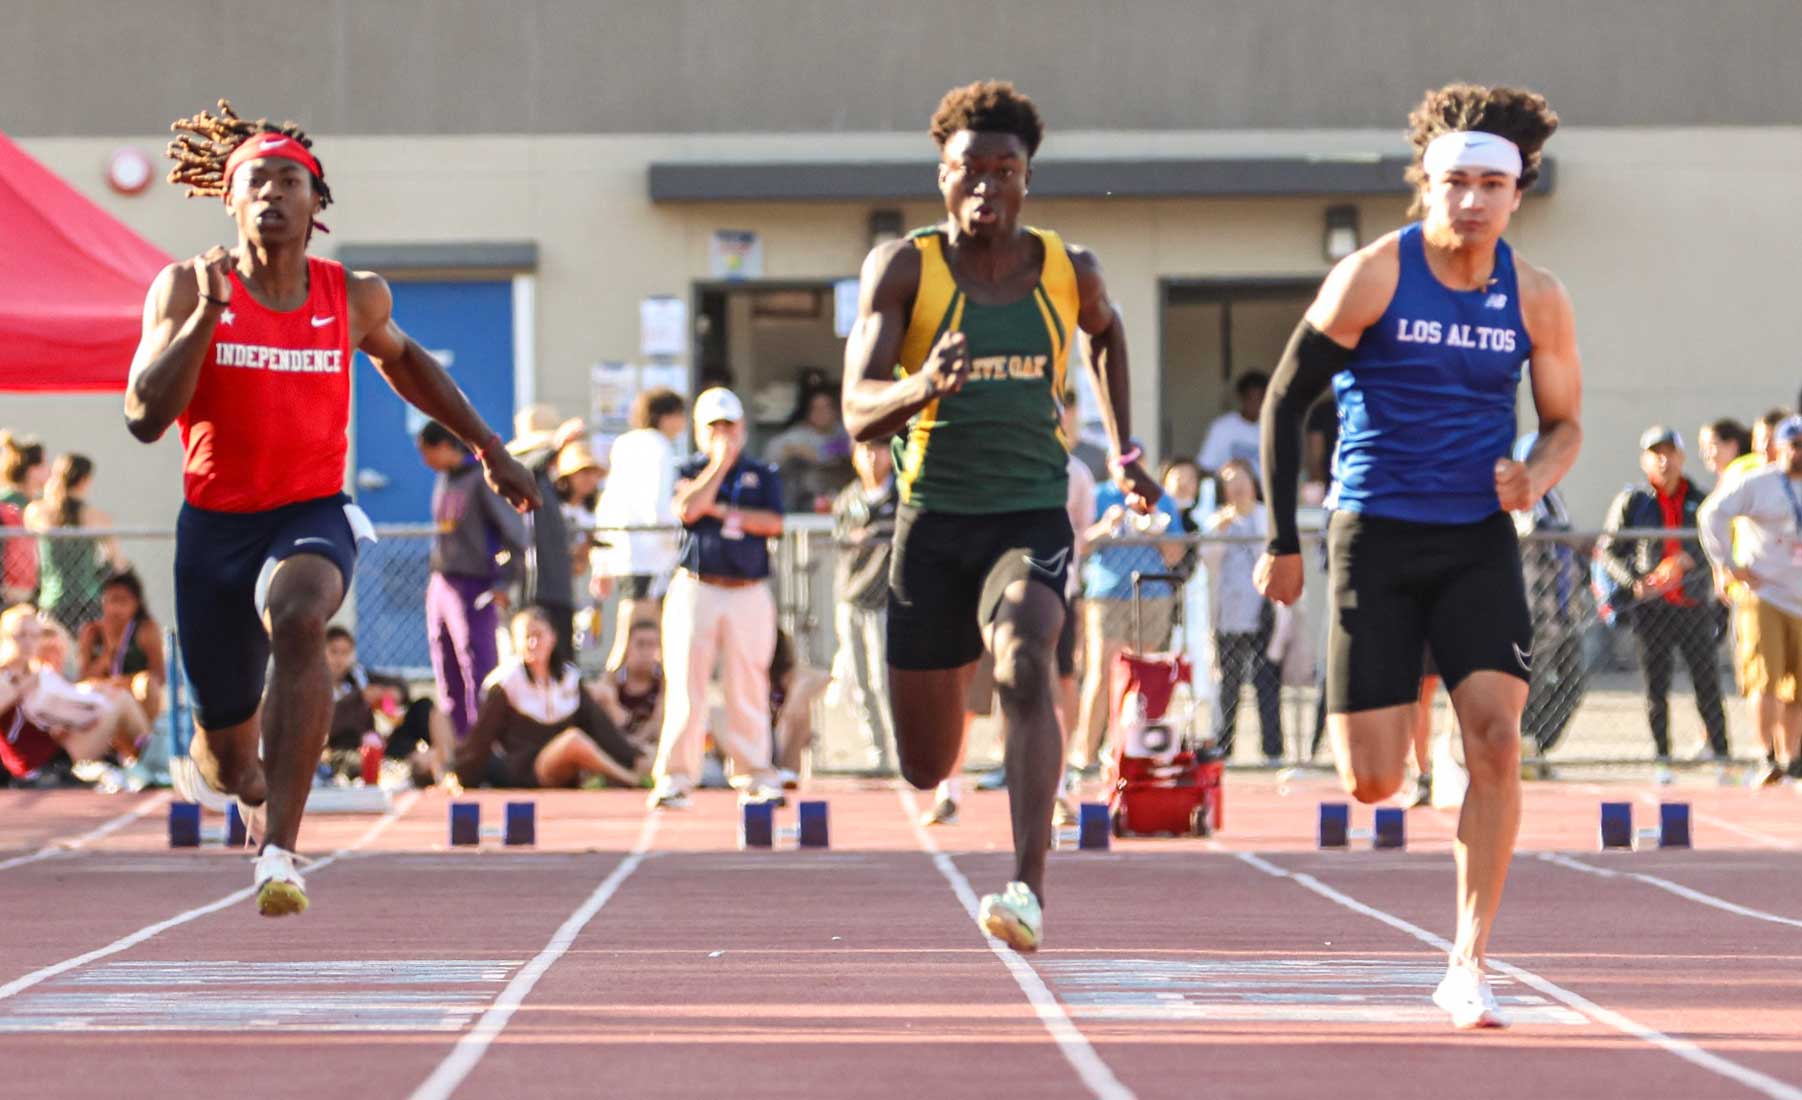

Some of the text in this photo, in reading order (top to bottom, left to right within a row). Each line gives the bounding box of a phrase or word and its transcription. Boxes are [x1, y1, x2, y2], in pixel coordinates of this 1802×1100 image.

[1397, 318, 1516, 352] LOS ALTOS
[216, 343, 342, 372] INDEPENDENCE
[1009, 354, 1048, 379] OAK
